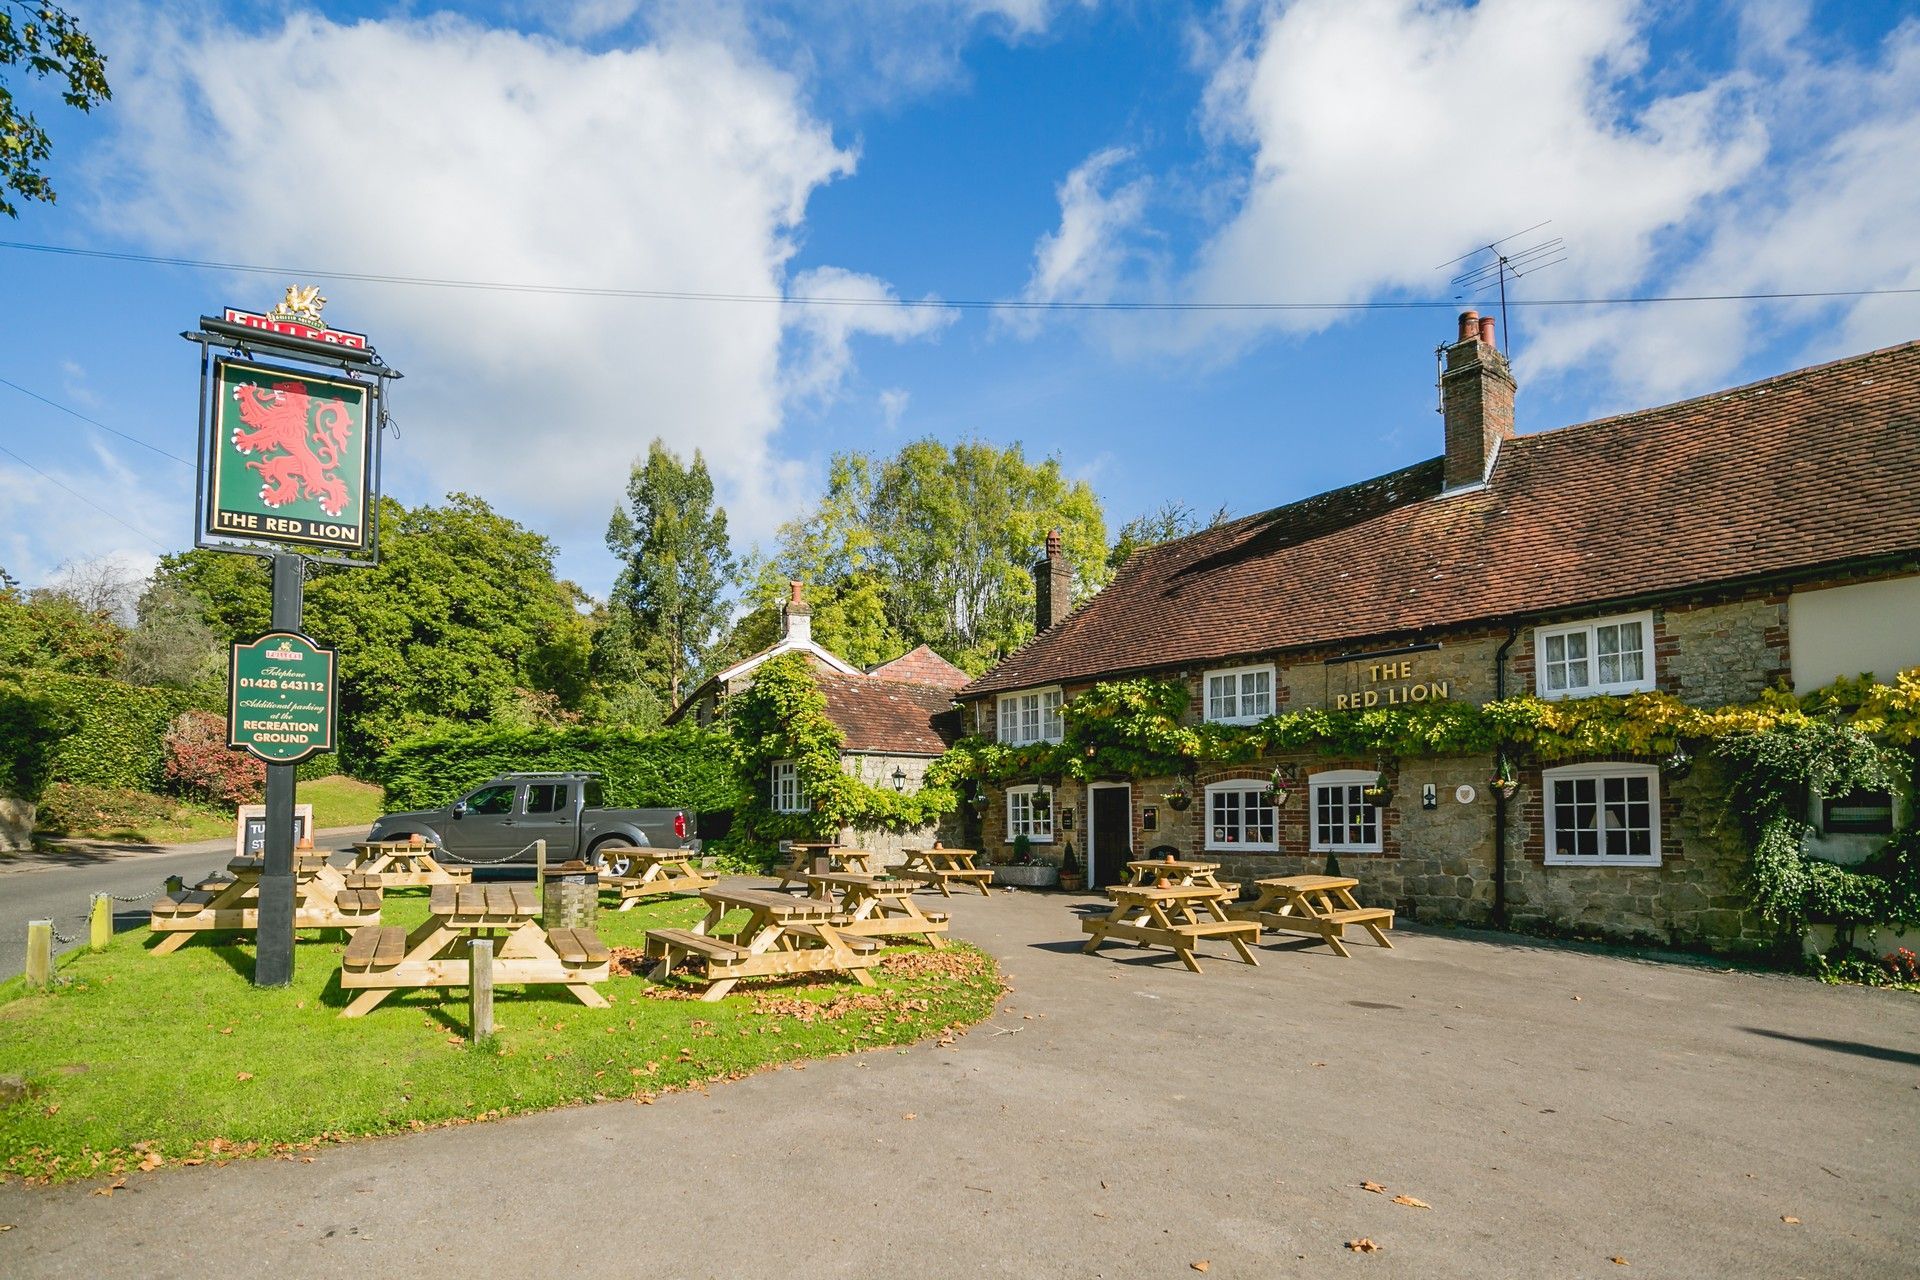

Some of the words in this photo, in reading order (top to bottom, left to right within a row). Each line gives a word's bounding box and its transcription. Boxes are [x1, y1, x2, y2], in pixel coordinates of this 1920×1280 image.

[221, 512, 258, 528] THE
[266, 517, 302, 533] RED
[310, 522, 356, 540] LION
[261, 666, 307, 679] Telephone
[1369, 661, 1412, 682] THE
[240, 678, 278, 689] 01428
[280, 680, 324, 692] 643112
[1337, 690, 1379, 710] RED
[1389, 681, 1448, 705] LION
[239, 699, 291, 711] Additional
[290, 702, 325, 714] parking
[280, 711, 293, 719] the
[243, 720, 319, 732] RECREATION
[253, 733, 309, 744] GROUND
